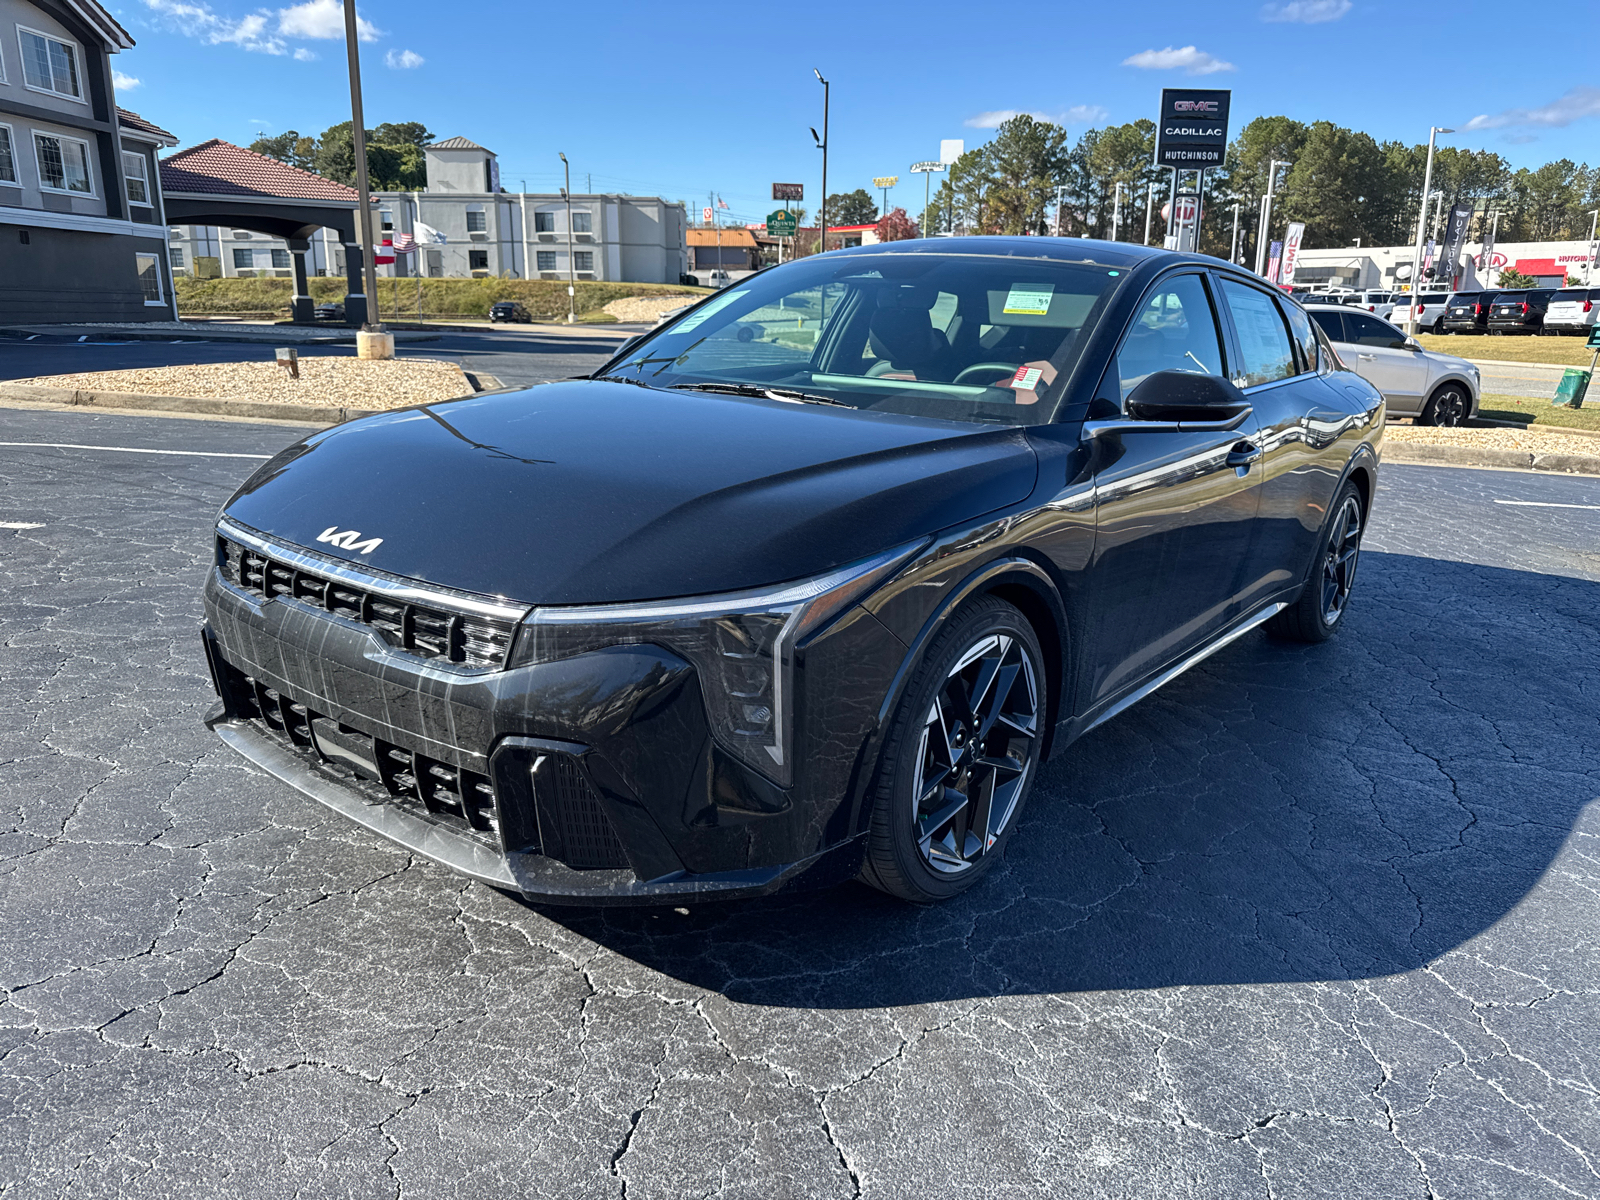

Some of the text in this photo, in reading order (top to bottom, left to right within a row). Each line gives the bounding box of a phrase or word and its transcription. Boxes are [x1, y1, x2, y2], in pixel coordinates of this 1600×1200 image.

[1174, 101, 1219, 112] GMC
[1165, 127, 1223, 136] CADILLAC
[1165, 150, 1219, 161] HUTCHINSON
[1284, 236, 1299, 274] GMC
[1446, 219, 1463, 272] CADILLAC
[316, 523, 384, 555] KIA
